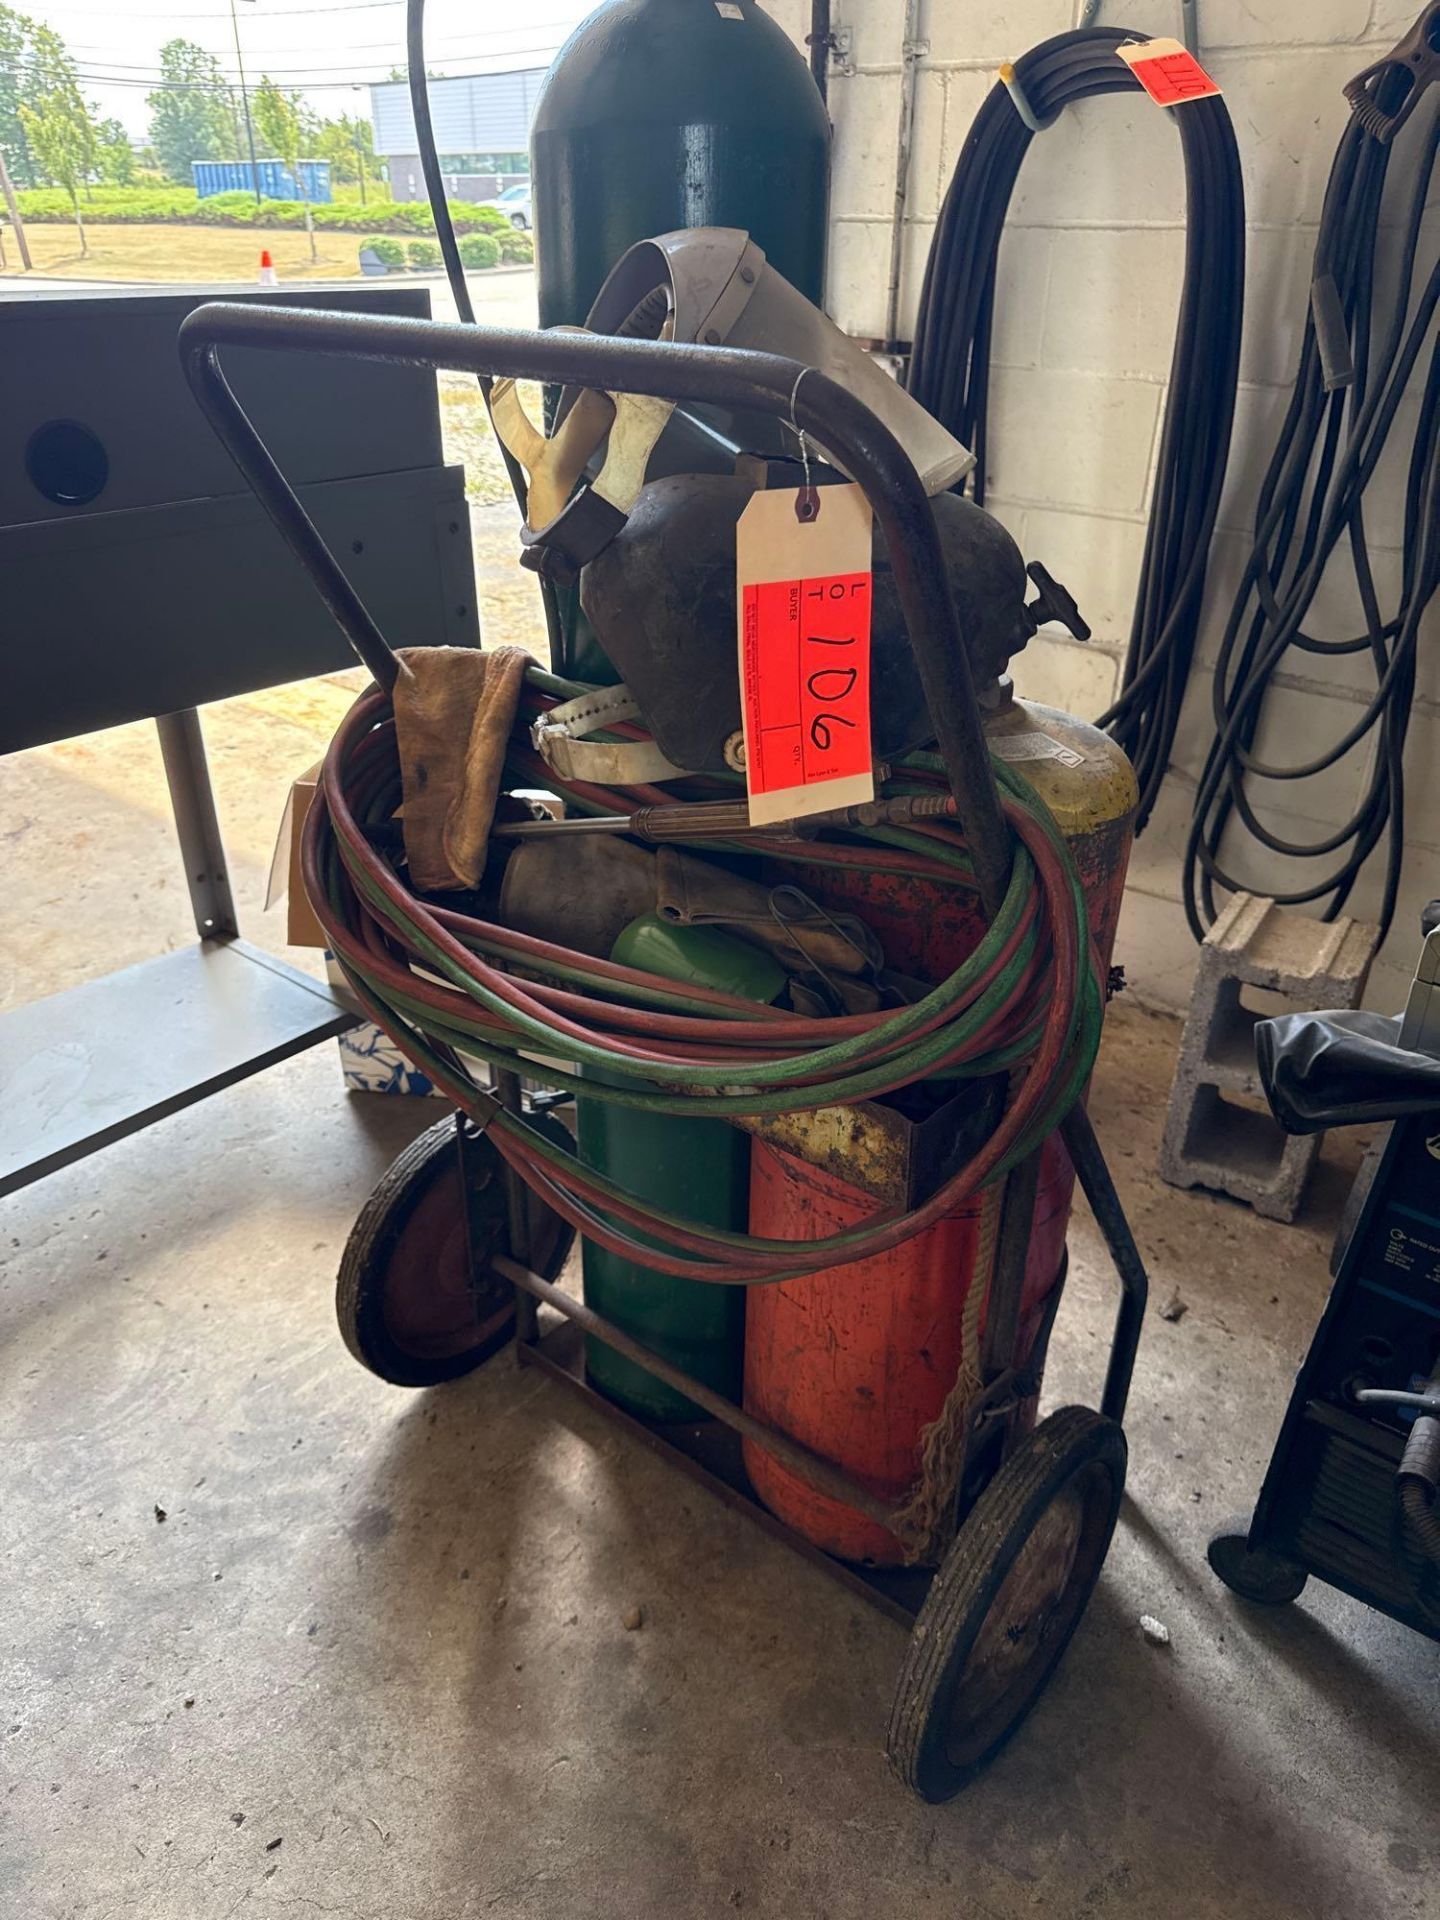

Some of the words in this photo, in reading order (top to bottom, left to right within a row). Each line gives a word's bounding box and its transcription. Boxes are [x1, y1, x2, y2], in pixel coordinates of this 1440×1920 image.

[789, 588, 798, 621] BUYER
[808, 583, 866, 601] LOT
[807, 637, 857, 750] 106
[793, 745, 801, 766] QTY.
